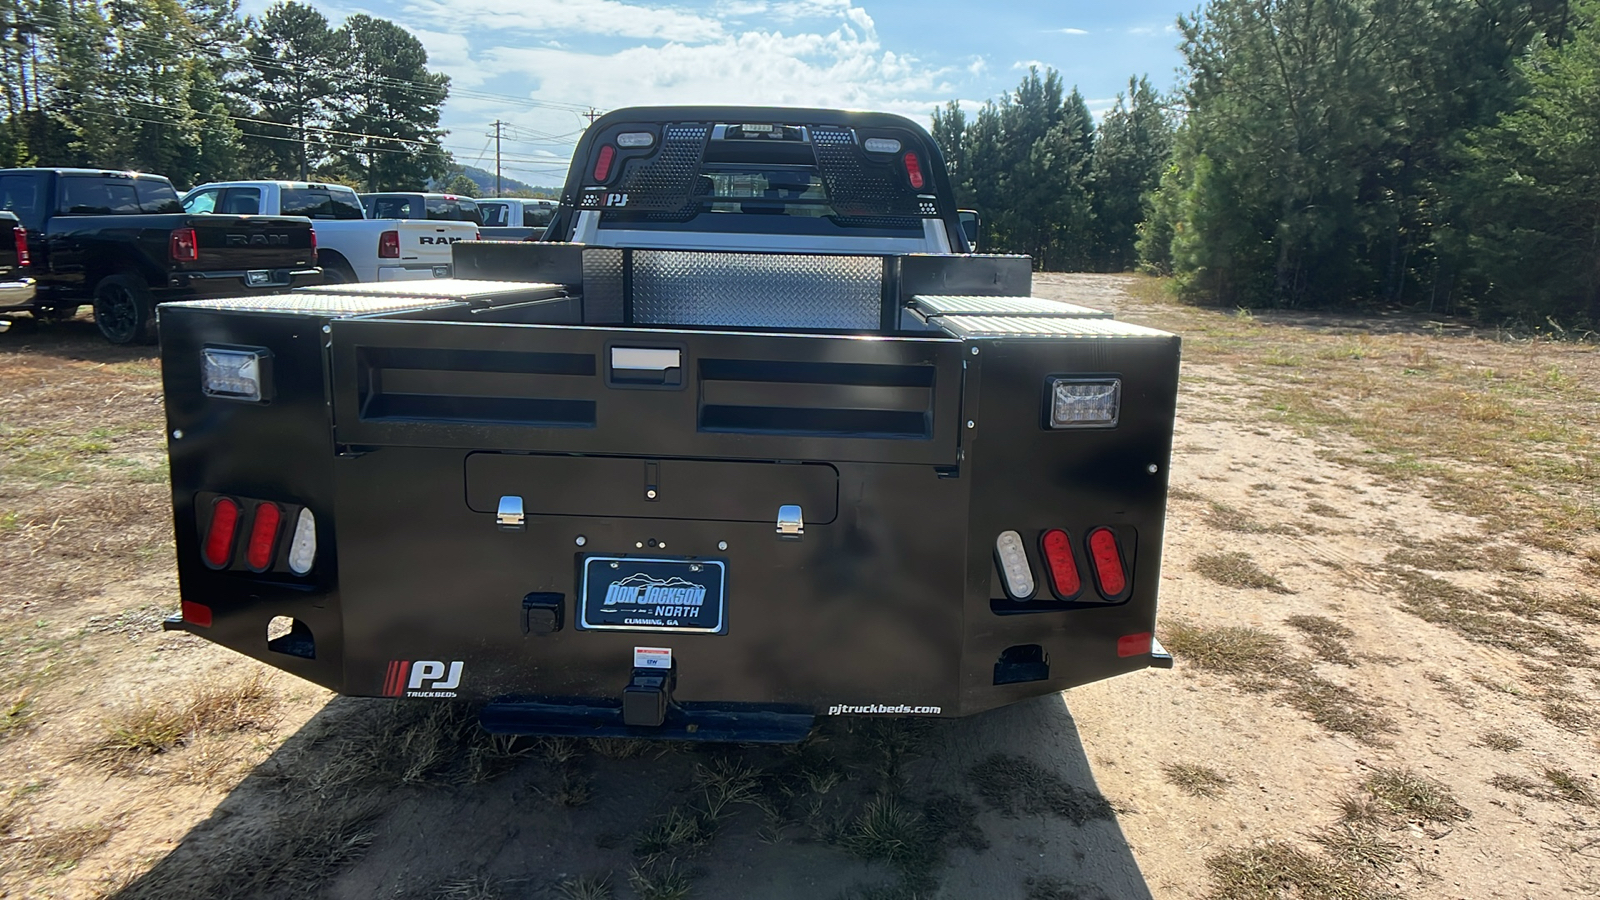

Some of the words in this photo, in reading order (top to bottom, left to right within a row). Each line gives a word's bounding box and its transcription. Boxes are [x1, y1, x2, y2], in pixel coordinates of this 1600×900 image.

[606, 193, 628, 206] PJ
[226, 234, 289, 245] RAM
[603, 584, 639, 605] DON
[637, 585, 706, 606] JACKSON
[654, 605, 700, 617] NORTH
[624, 618, 664, 626] CUMMING,
[408, 661, 464, 689] PJ
[828, 704, 941, 715] pjtruckbeds.com
